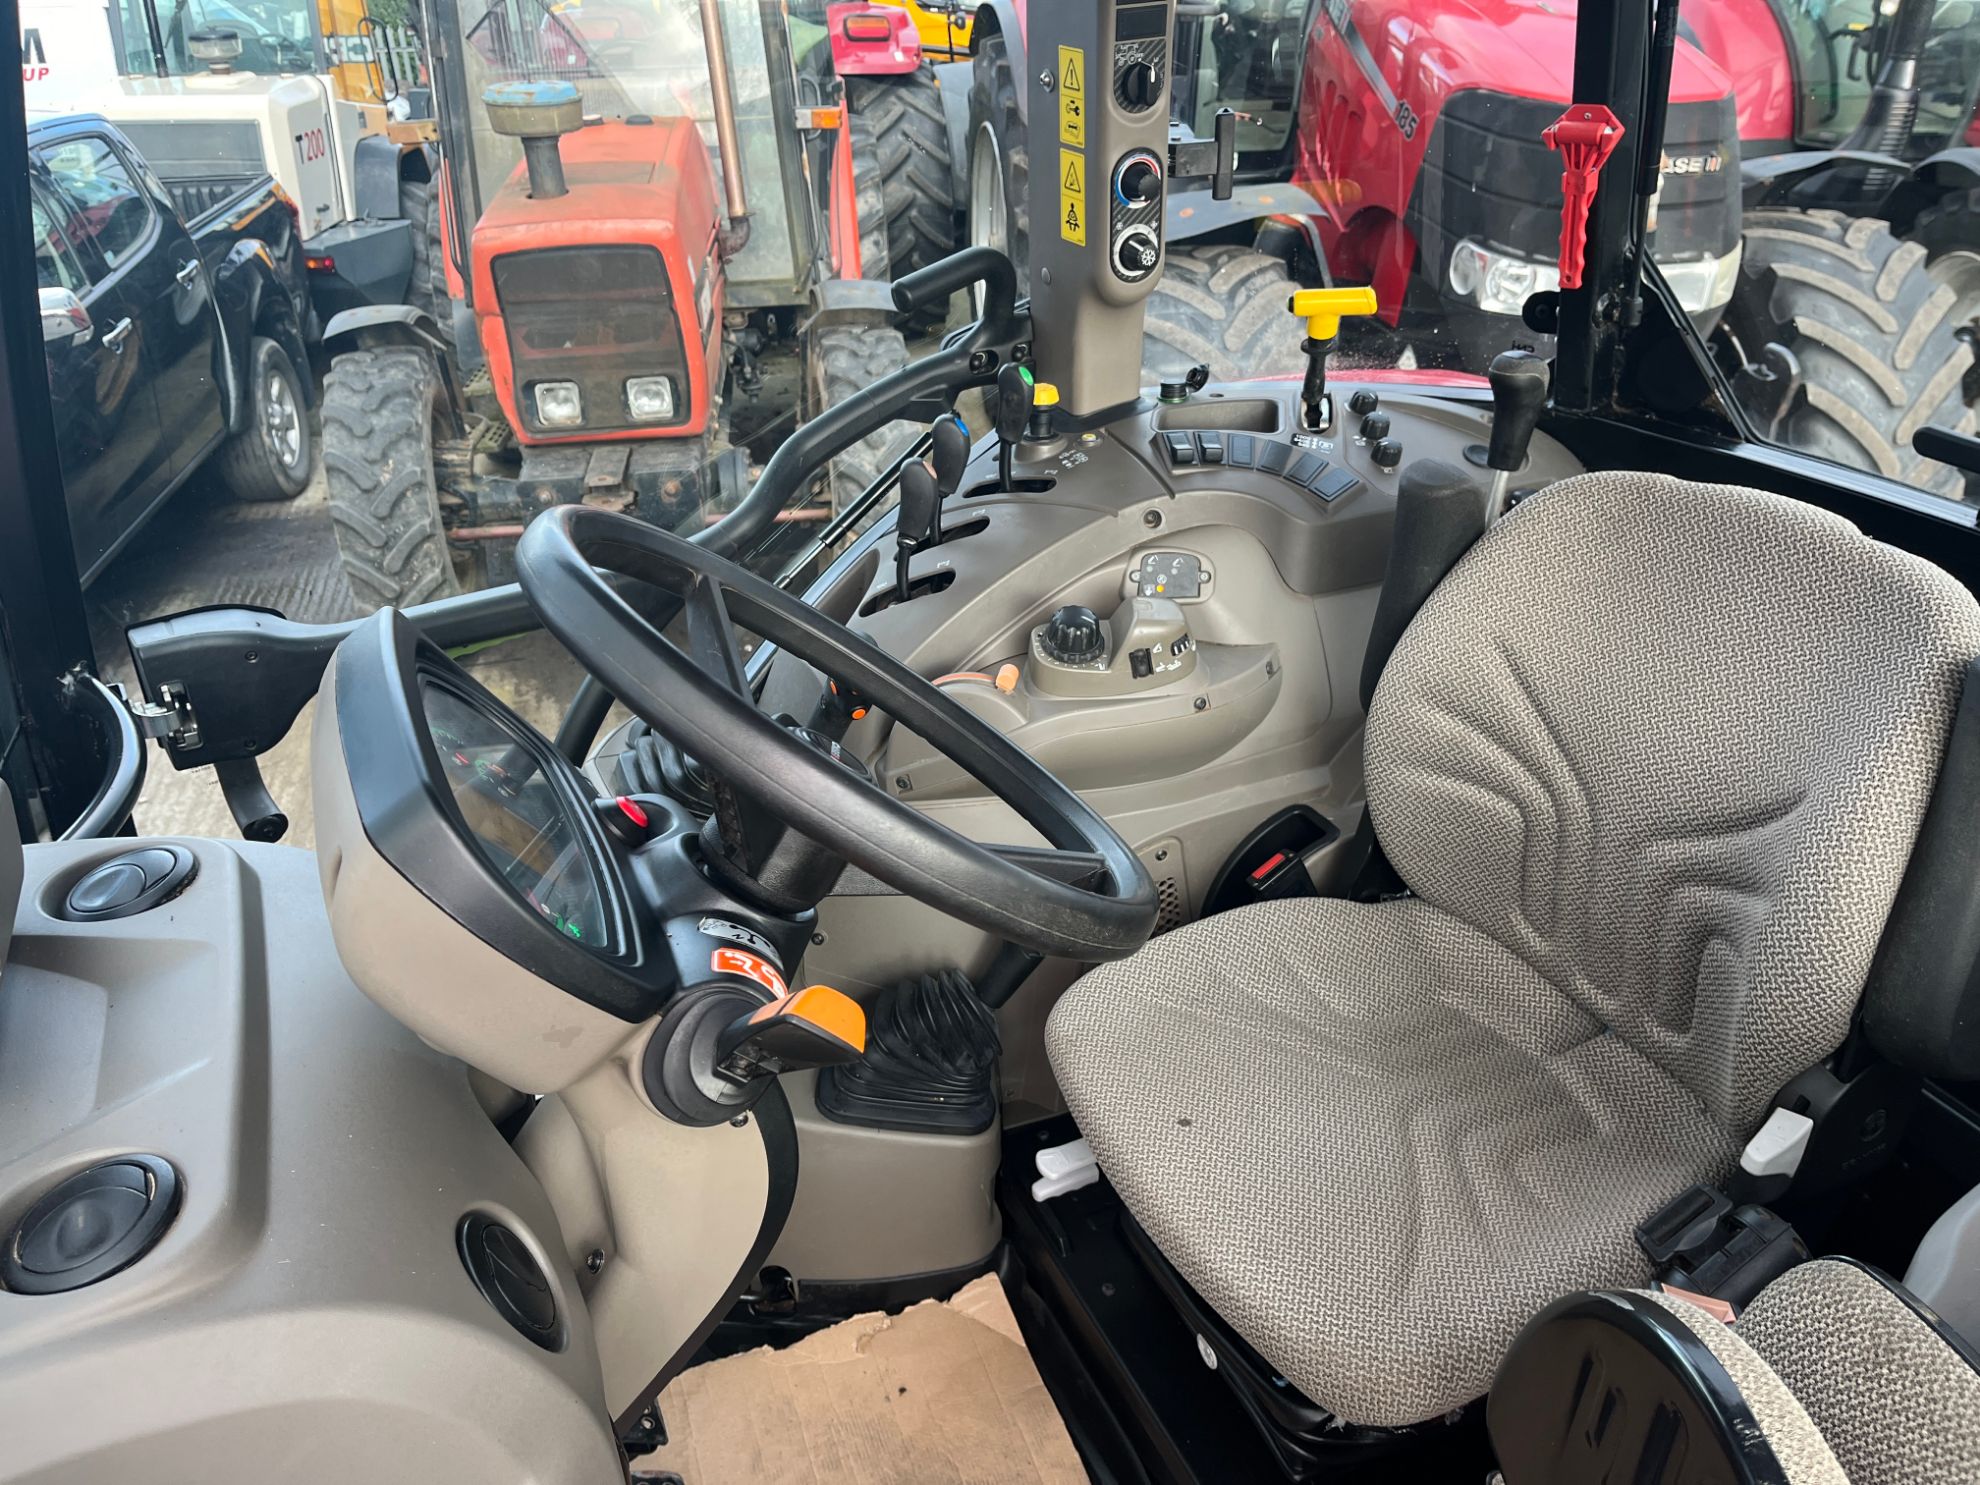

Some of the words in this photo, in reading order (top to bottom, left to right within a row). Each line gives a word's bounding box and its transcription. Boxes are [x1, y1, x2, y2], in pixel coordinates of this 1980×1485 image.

[1395, 99, 1419, 142] 185
[294, 127, 326, 165] T200
[1660, 156, 1702, 174] ASE
